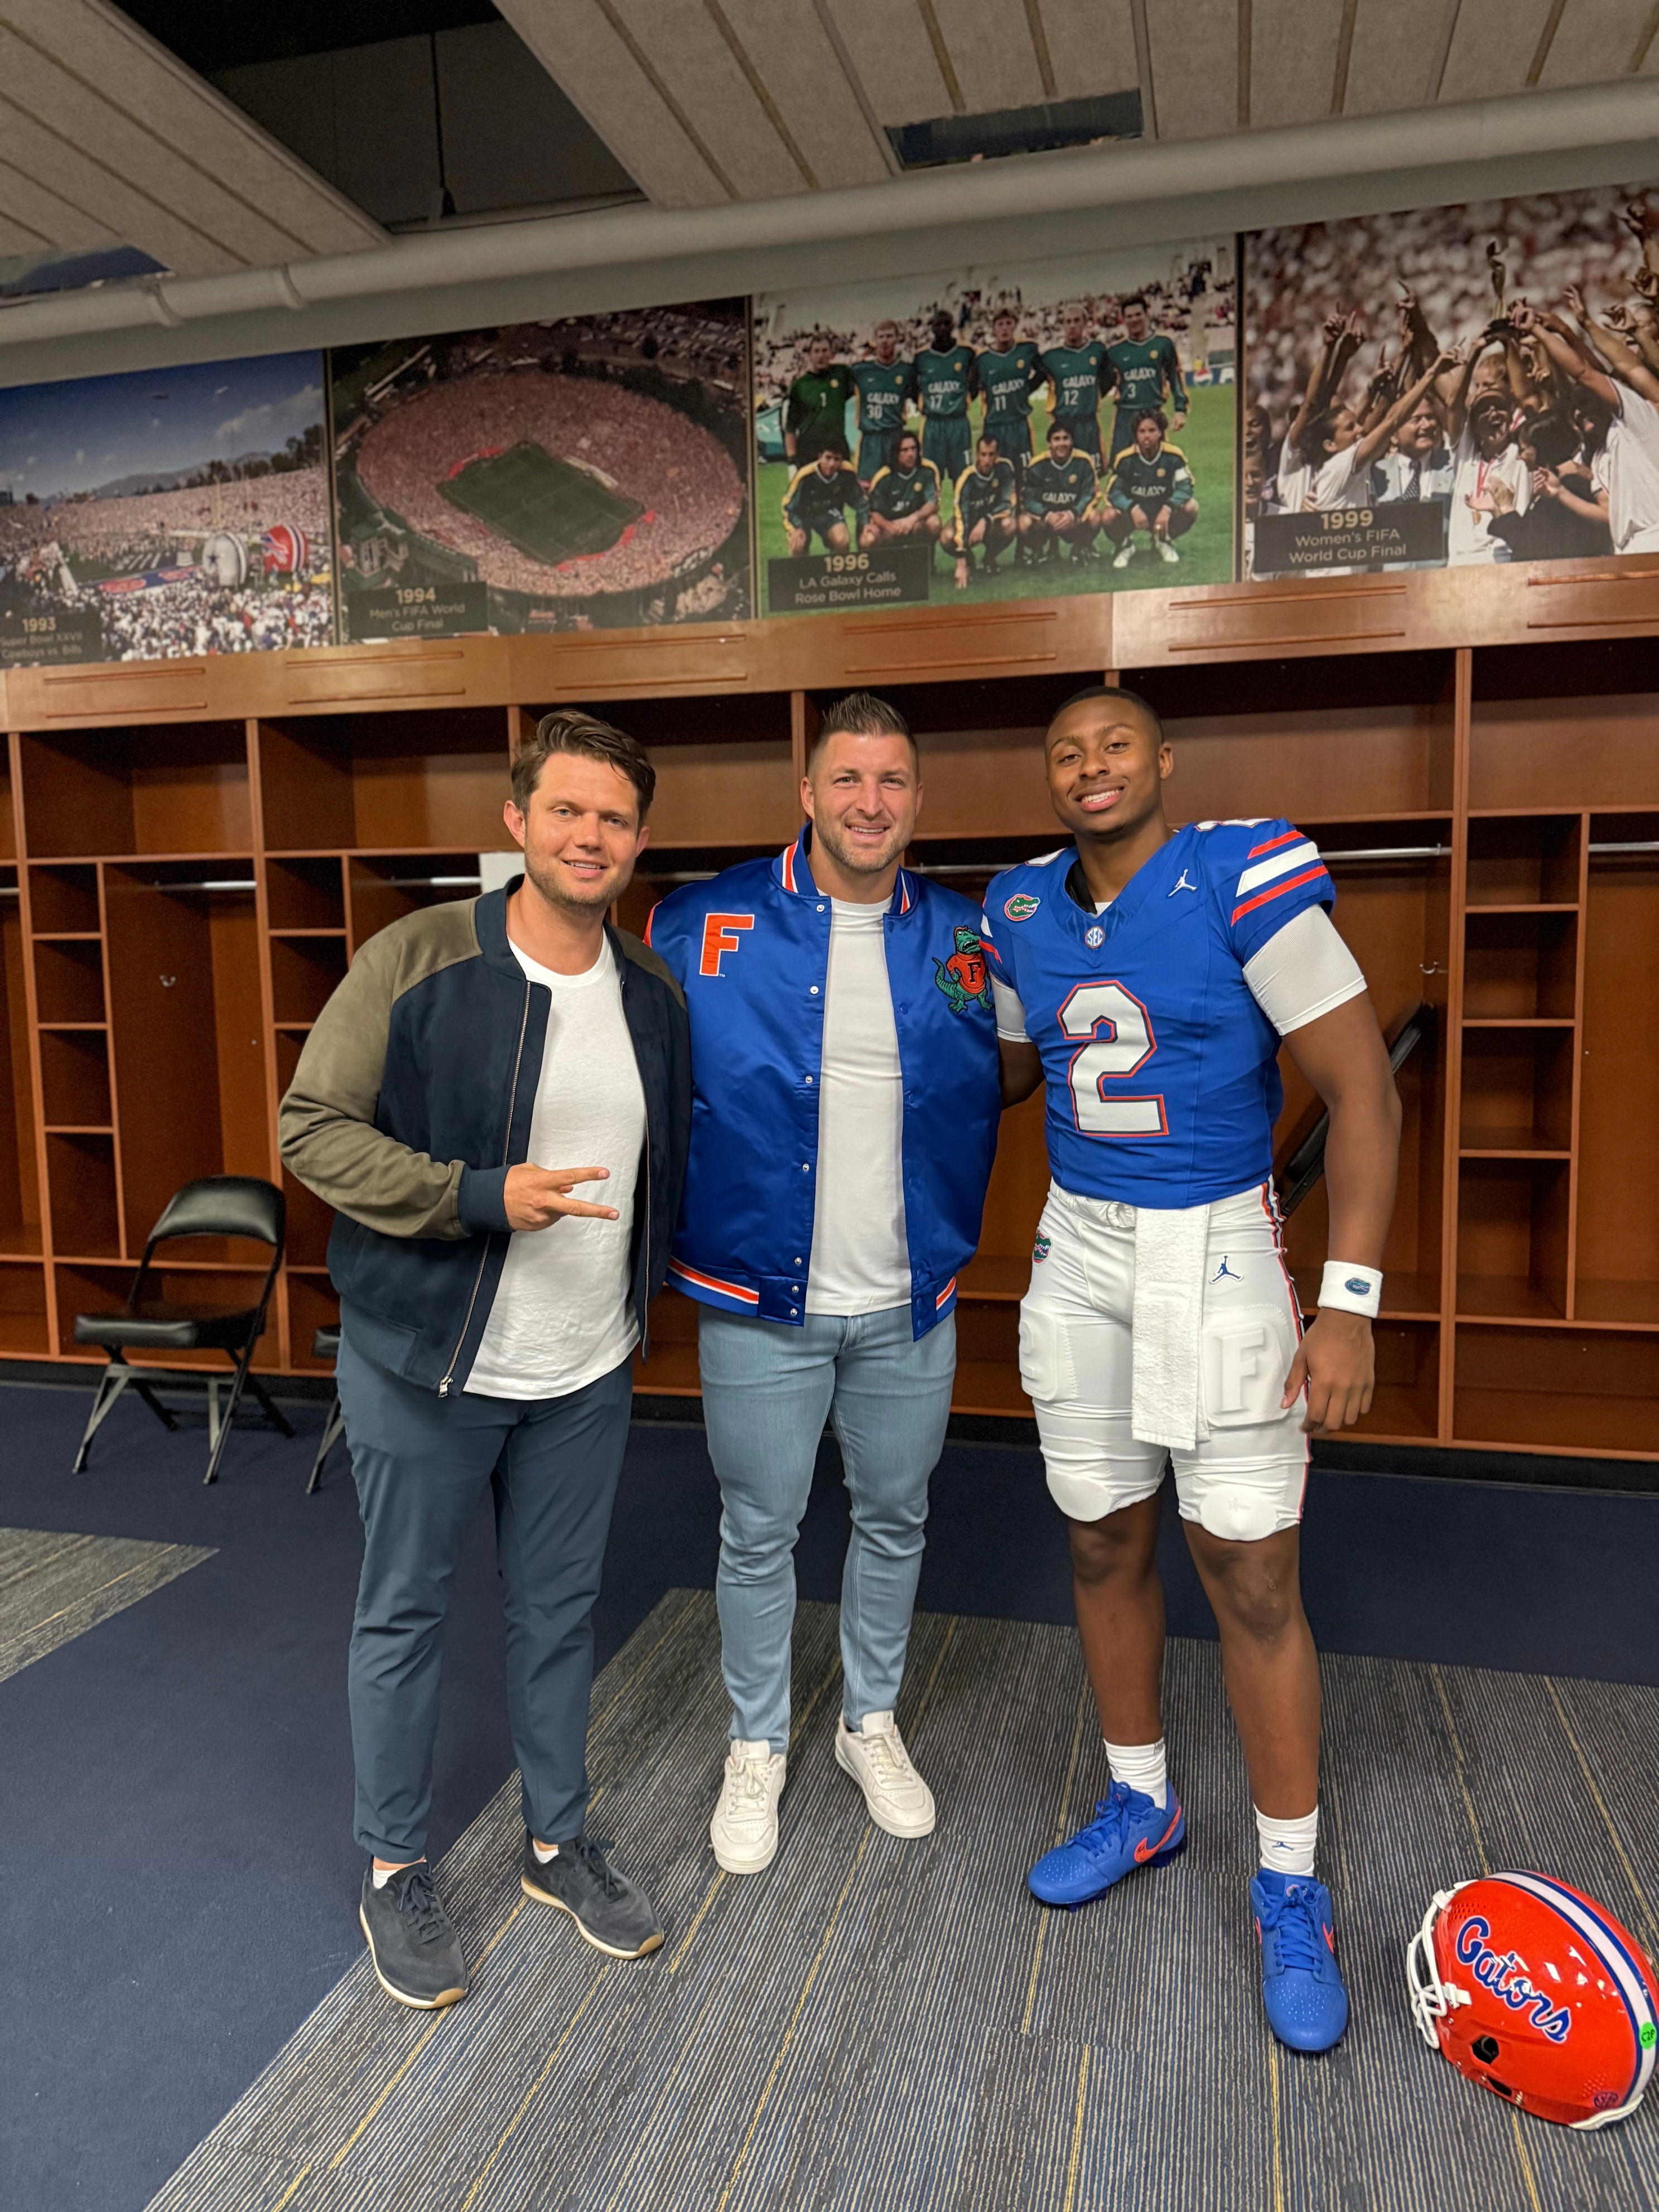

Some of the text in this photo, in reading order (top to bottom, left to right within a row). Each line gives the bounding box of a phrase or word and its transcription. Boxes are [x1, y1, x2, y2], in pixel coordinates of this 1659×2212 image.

[1063, 375, 1096, 388] GALAXY
[1124, 367, 1156, 381] GALAXY
[928, 380, 961, 393] GALAXY
[992, 379, 1024, 395] GALAXY
[1127, 383, 1136, 399] 3
[819, 392, 826, 407] 1
[867, 392, 899, 404] GALAXY
[930, 394, 943, 409] 17
[994, 395, 1006, 412] 11
[1064, 390, 1078, 405] 12
[866, 404, 882, 419] 30
[1042, 492, 1077, 504] GALAXY
[1131, 486, 1166, 497] GALAXY
[1321, 509, 1373, 530] 1999
[1295, 528, 1400, 547] Women's FIFA
[1289, 544, 1406, 563] World Cup Final
[824, 553, 870, 572] 1996
[799, 571, 896, 588] LA Galaxy Calls
[396, 587, 436, 604] 1994
[795, 585, 902, 605] Rose Bowl Home
[369, 603, 465, 618] Men's FIFA World
[22, 616, 56, 632] 1993
[392, 619, 443, 632] Cup Final
[700, 913, 755, 977] F
[1085, 926, 1105, 948] SEC
[968, 962, 981, 983] F
[1057, 980, 1169, 1136] 2
[1216, 1328, 1265, 1413] F
[1456, 1916, 1571, 2042] Gators
